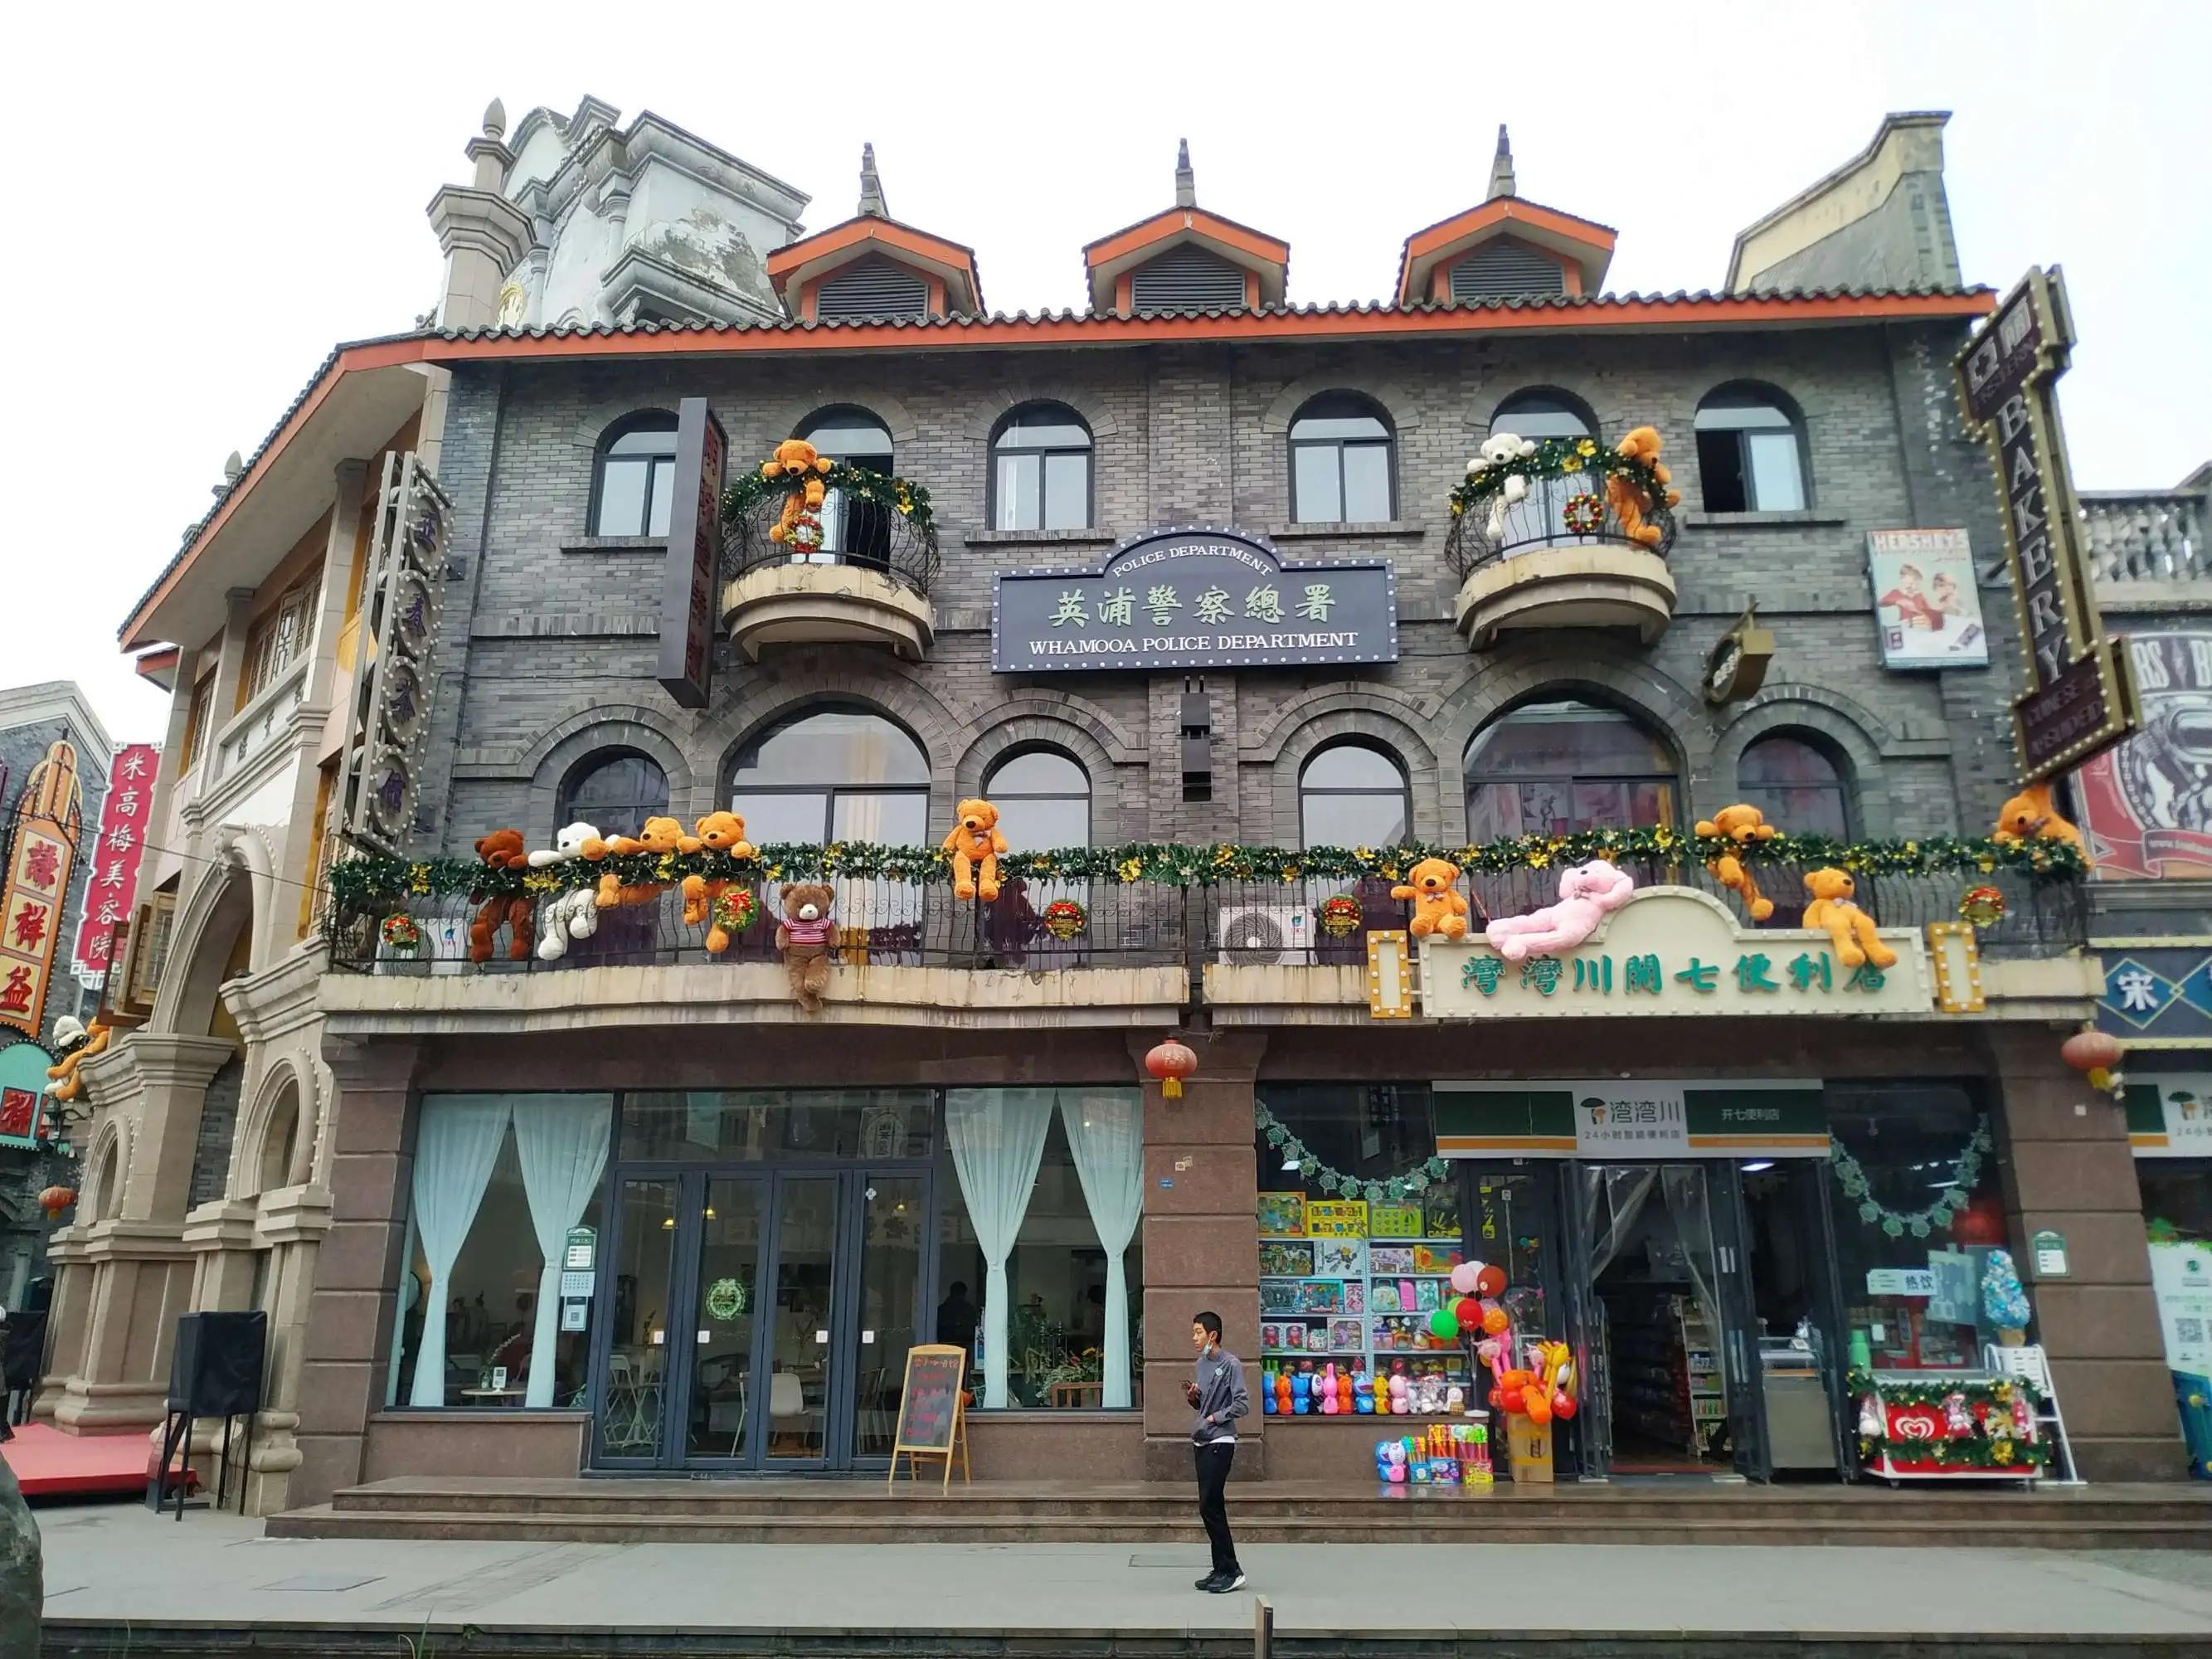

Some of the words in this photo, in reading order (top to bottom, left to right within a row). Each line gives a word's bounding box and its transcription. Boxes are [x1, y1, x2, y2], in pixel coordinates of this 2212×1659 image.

[1996, 393, 2065, 685] BAKERY
[1112, 548, 1166, 578] POLICE
[1169, 544, 1273, 578] DEPARTMENT
[1048, 583, 1337, 630] 英浦警察總署
[1028, 638, 1138, 656] WHAMOOA
[1142, 635, 1211, 652] POLICE
[1218, 631, 1359, 650] DEPARTMENT
[88, 752, 147, 961] 米高梅美容院
[1460, 951, 1887, 996] 灣灣川開七便利店
[1609, 1100, 1680, 1124] 湾湾川
[1721, 1107, 1781, 1121] 开七便利店
